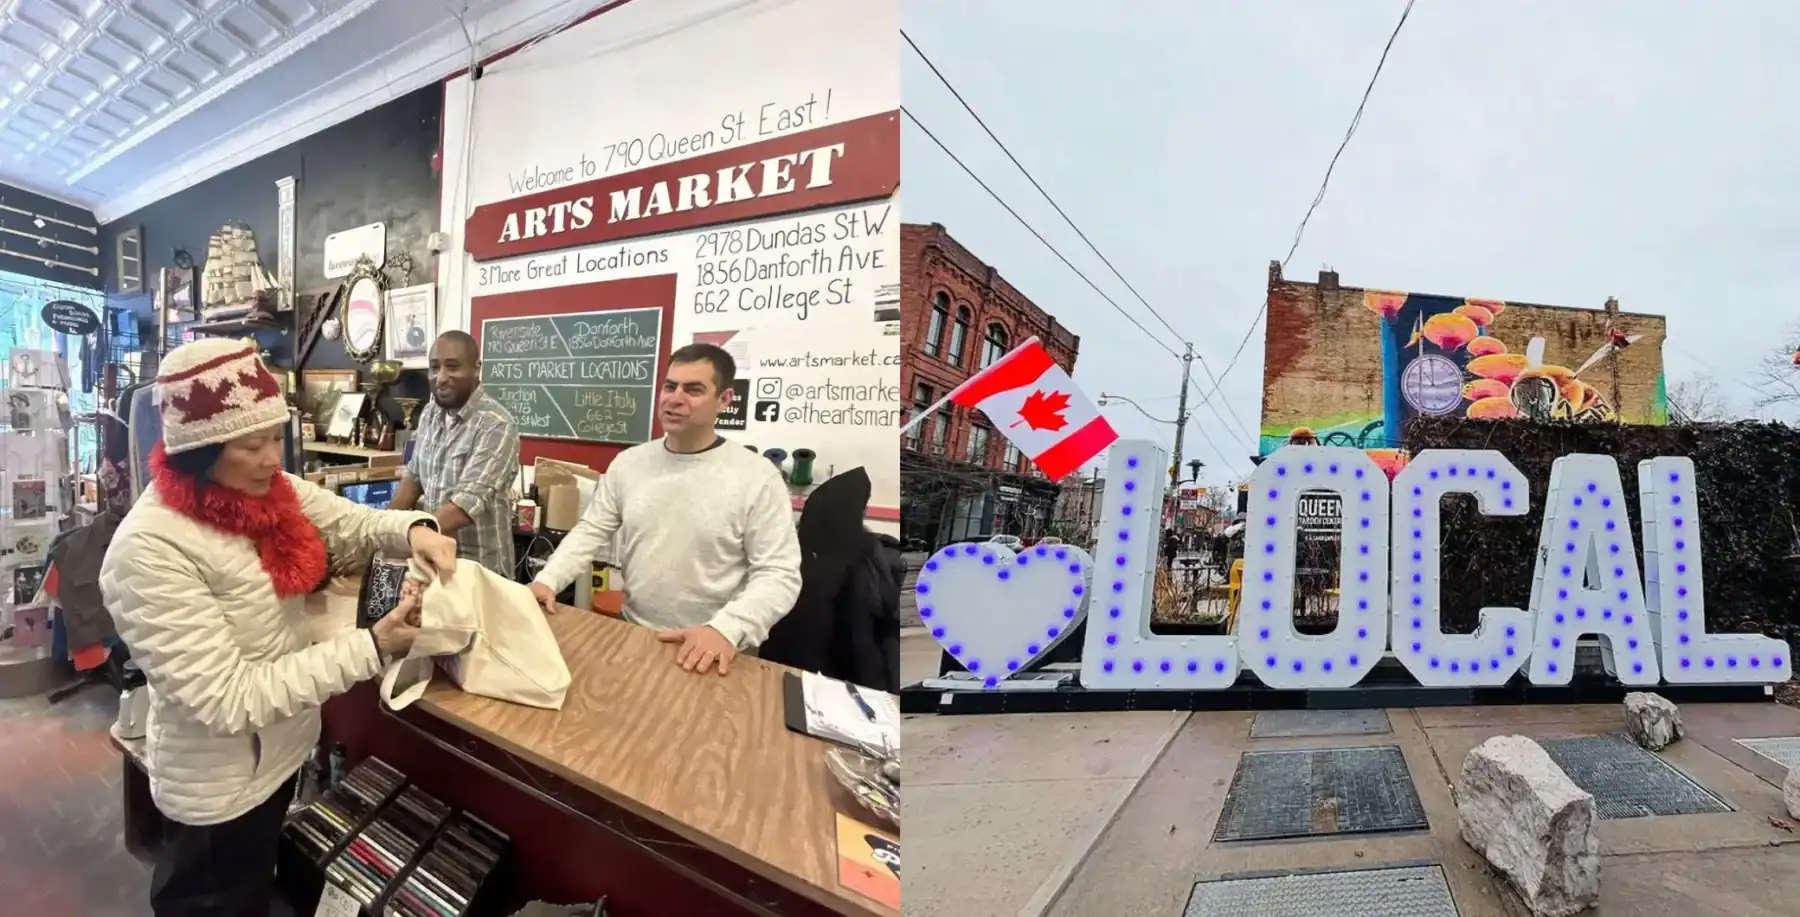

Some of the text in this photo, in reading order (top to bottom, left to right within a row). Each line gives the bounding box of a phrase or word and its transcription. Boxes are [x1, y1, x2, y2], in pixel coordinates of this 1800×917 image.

[508, 164, 574, 195] Welcome
[580, 153, 597, 177] to
[602, 143, 643, 172] 790
[648, 132, 715, 162] Queen
[498, 143, 845, 244] ARTS MARKET
[695, 229, 743, 259] 2978
[746, 221, 826, 252] Dundas
[488, 264, 521, 284] More
[527, 260, 569, 281] Great
[577, 248, 669, 274] Locations
[696, 262, 742, 286] 1856
[744, 248, 832, 282] Danforth
[694, 290, 729, 314] 662
[738, 284, 820, 321] College
[490, 322, 543, 340] Riverside
[574, 316, 639, 337] Danforth
[504, 338, 537, 353] Queen
[550, 334, 558, 349] E
[568, 335, 593, 350] 1856
[592, 334, 636, 349] Danforth
[760, 349, 900, 367] www.artsmarket.ca
[490, 359, 648, 380] ARTS MARKET LOCATIONS
[574, 389, 604, 407] Little
[530, 412, 551, 428] West
[586, 408, 613, 421] 662
[1299, 499, 1342, 517] QUEEN
[1081, 439, 1793, 690] LOCAL
